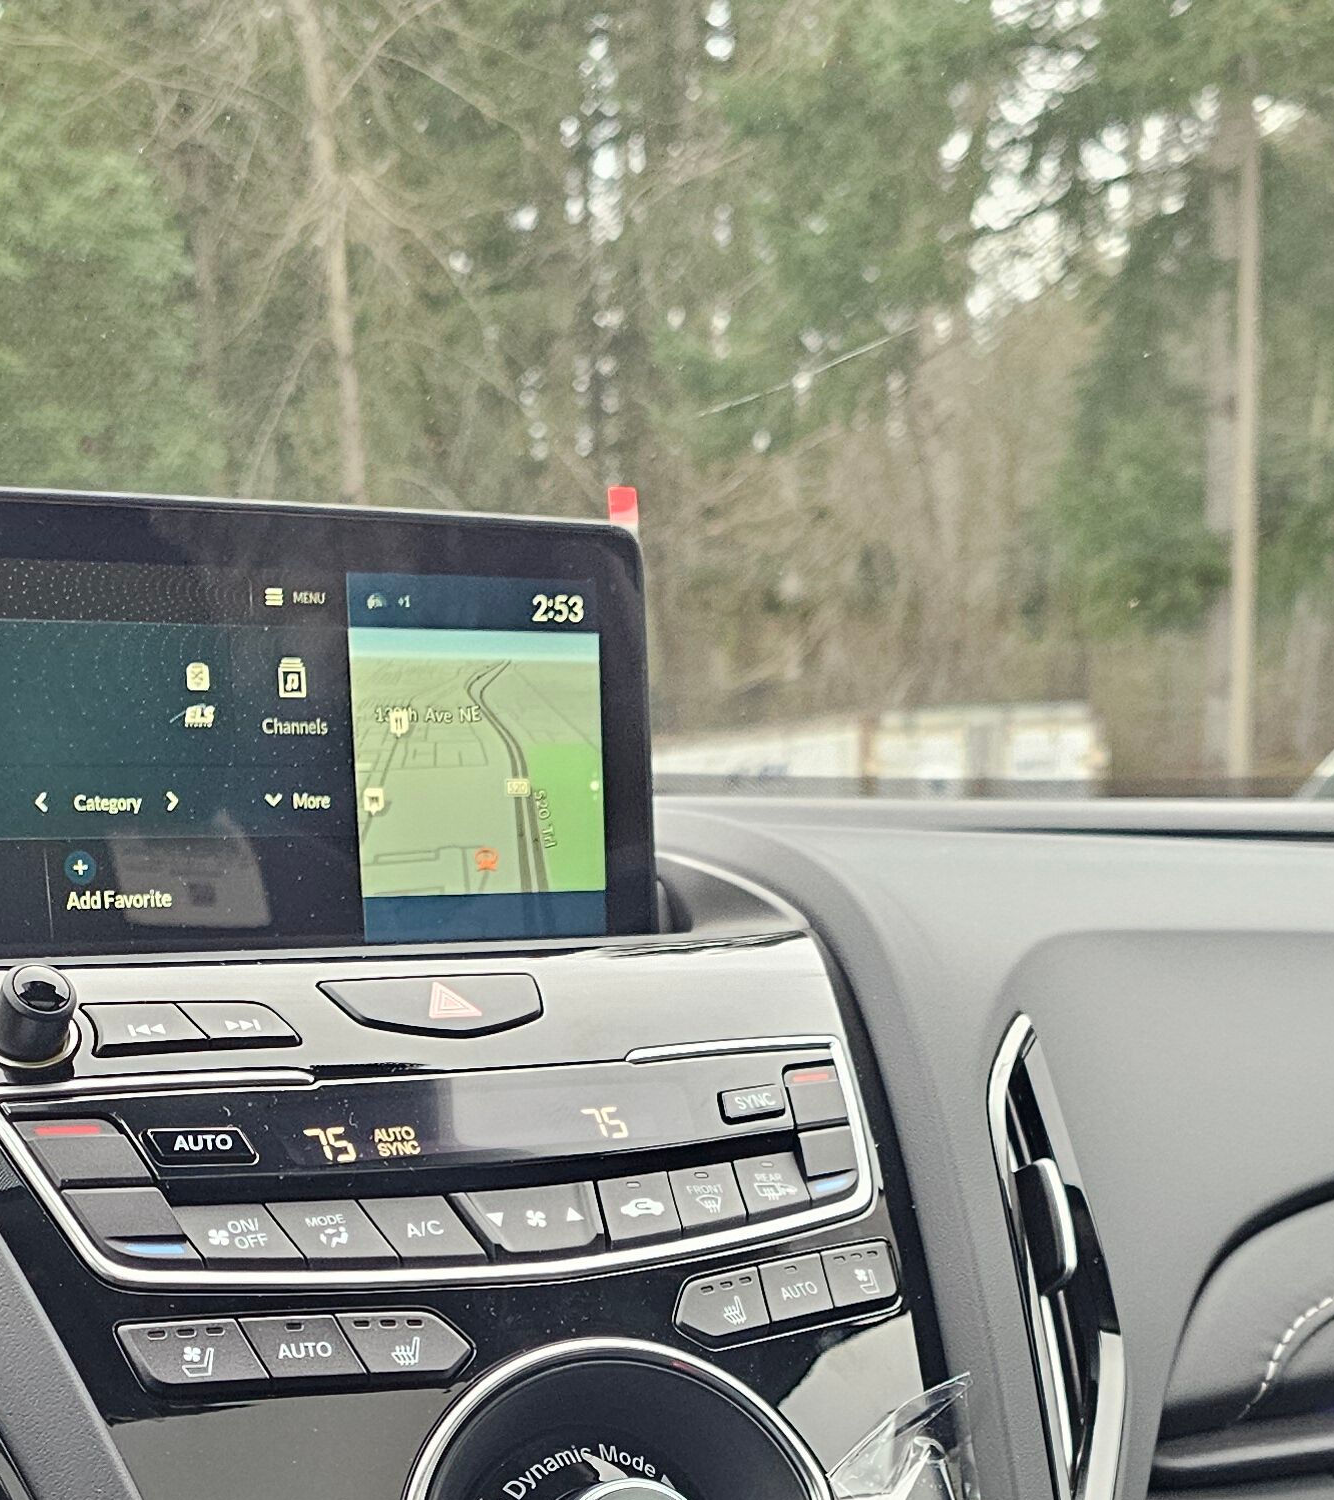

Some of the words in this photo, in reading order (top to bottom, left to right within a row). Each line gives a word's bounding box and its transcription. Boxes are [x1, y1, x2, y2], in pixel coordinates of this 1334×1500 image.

[293, 592, 326, 605] MENU
[532, 594, 585, 623] 2:53
[426, 707, 453, 724] Ave
[460, 705, 482, 722] NE
[262, 718, 329, 735] Channels
[74, 794, 142, 814] Category
[293, 793, 331, 809] More
[535, 790, 552, 820] 520
[67, 891, 101, 910] Add
[104, 889, 172, 909] Favorite
[734, 1093, 776, 1111] SYNC
[581, 1106, 628, 1139] 75
[174, 1133, 233, 1152] AUTO
[374, 1126, 415, 1143] AUTO
[304, 1126, 357, 1163] 75
[378, 1140, 421, 1157] SYNC
[754, 1172, 783, 1184] REAR
[687, 1182, 724, 1196] FRONT
[227, 1218, 259, 1236] ON/
[306, 1213, 346, 1228] MODE
[406, 1219, 445, 1239] A/C
[234, 1232, 269, 1249] OFF
[781, 1281, 819, 1301] AUTO
[278, 1342, 333, 1360] AUTO
[502, 1445, 591, 1500] Dynamic
[598, 1443, 657, 1477] Mode
